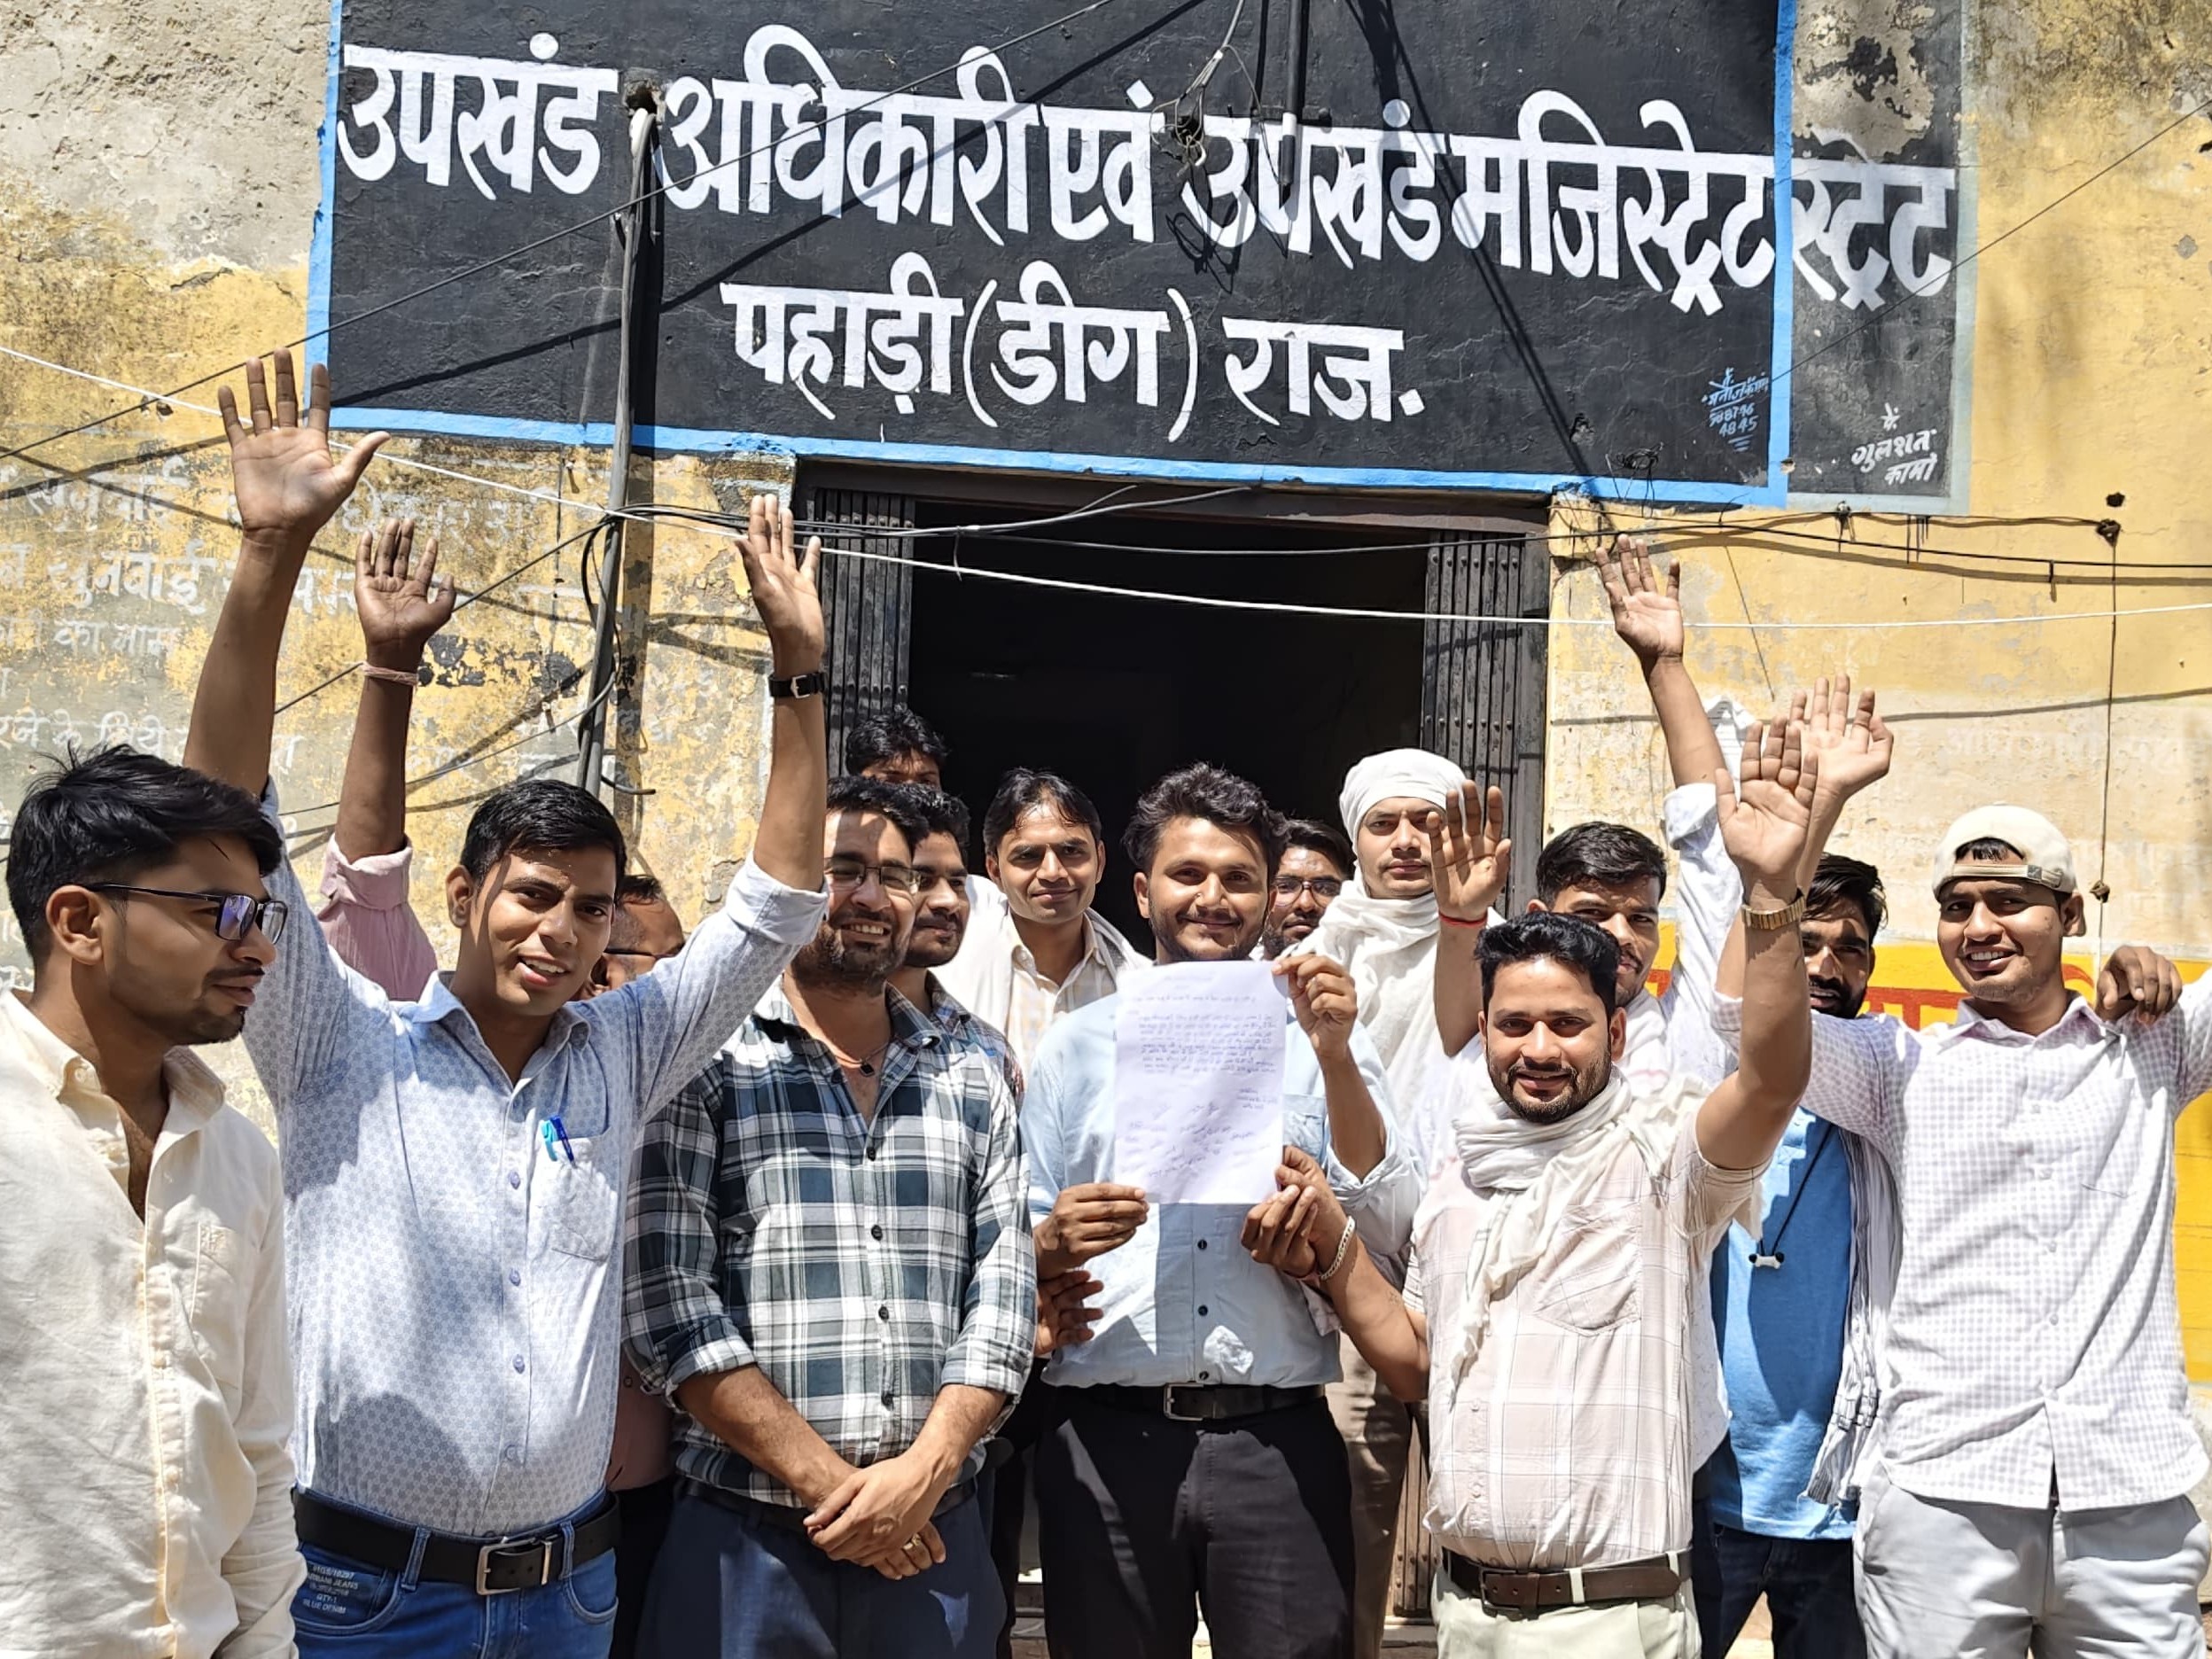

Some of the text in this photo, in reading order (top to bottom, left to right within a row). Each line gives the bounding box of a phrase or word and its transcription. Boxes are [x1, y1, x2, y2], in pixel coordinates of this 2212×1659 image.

[337, 23, 1776, 316] उपखंड अधिकारी एवं उपखंड मजिस्ट्रेट
[720, 252, 1427, 442] पहाड़ी (डीग) राज.
